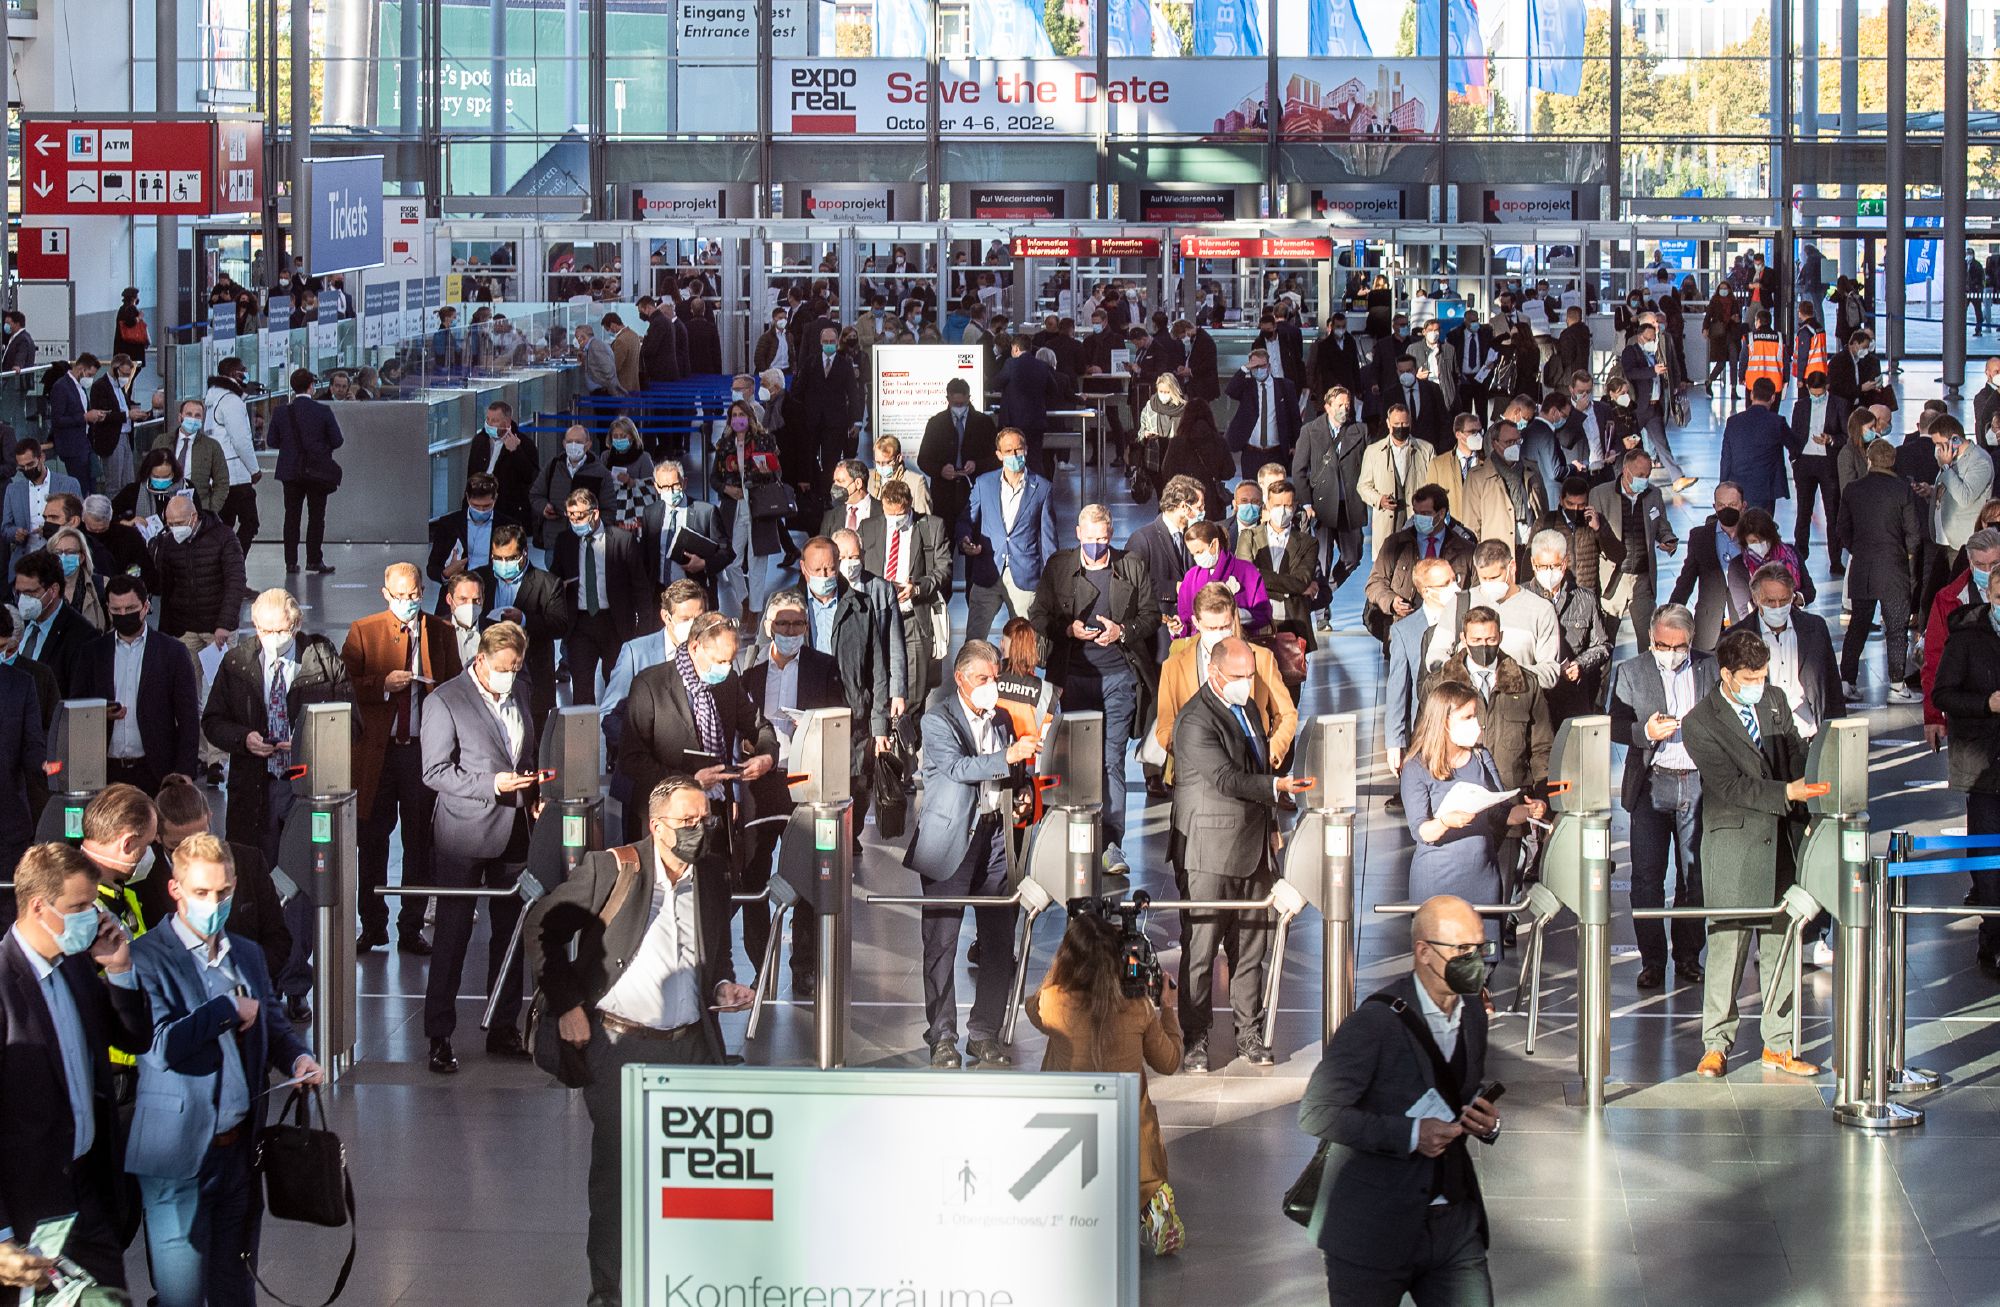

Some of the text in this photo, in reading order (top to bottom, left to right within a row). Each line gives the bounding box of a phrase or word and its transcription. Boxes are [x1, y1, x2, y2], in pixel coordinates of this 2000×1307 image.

[683, 5, 746, 21] Eingang
[684, 24, 797, 37] Entrance est
[792, 68, 857, 95] expo
[887, 72, 1169, 103] Save the Date
[792, 92, 857, 110] real
[886, 116, 957, 130] Octoer
[1007, 116, 1055, 130] 2022
[104, 140, 130, 150] ATM
[186, 173, 199, 181] WC
[649, 198, 717, 212] apoprojekt
[818, 198, 886, 212] apoprojekt
[980, 195, 993, 203] Auf
[994, 195, 1046, 203] Wiedersehen
[1150, 195, 1163, 203] Auf
[1164, 195, 1216, 203] Wiedersehen
[1329, 198, 1398, 213] apoprojekt
[1502, 199, 1571, 213] apoprojekt
[328, 187, 368, 240] Tickets
[1027, 238, 1069, 247] Information
[1102, 238, 1143, 247] Information
[1199, 239, 1240, 247] Information
[1273, 239, 1315, 247] Information
[1027, 248, 1069, 256] Information
[1199, 248, 1240, 256] Information
[1273, 248, 1315, 256] Information
[997, 681, 1039, 698] CURITY
[661, 1105, 774, 1153] expo
[661, 1147, 774, 1181] real
[1069, 1214, 1099, 1227] floor
[665, 1274, 1014, 1307] Konferenzräume
